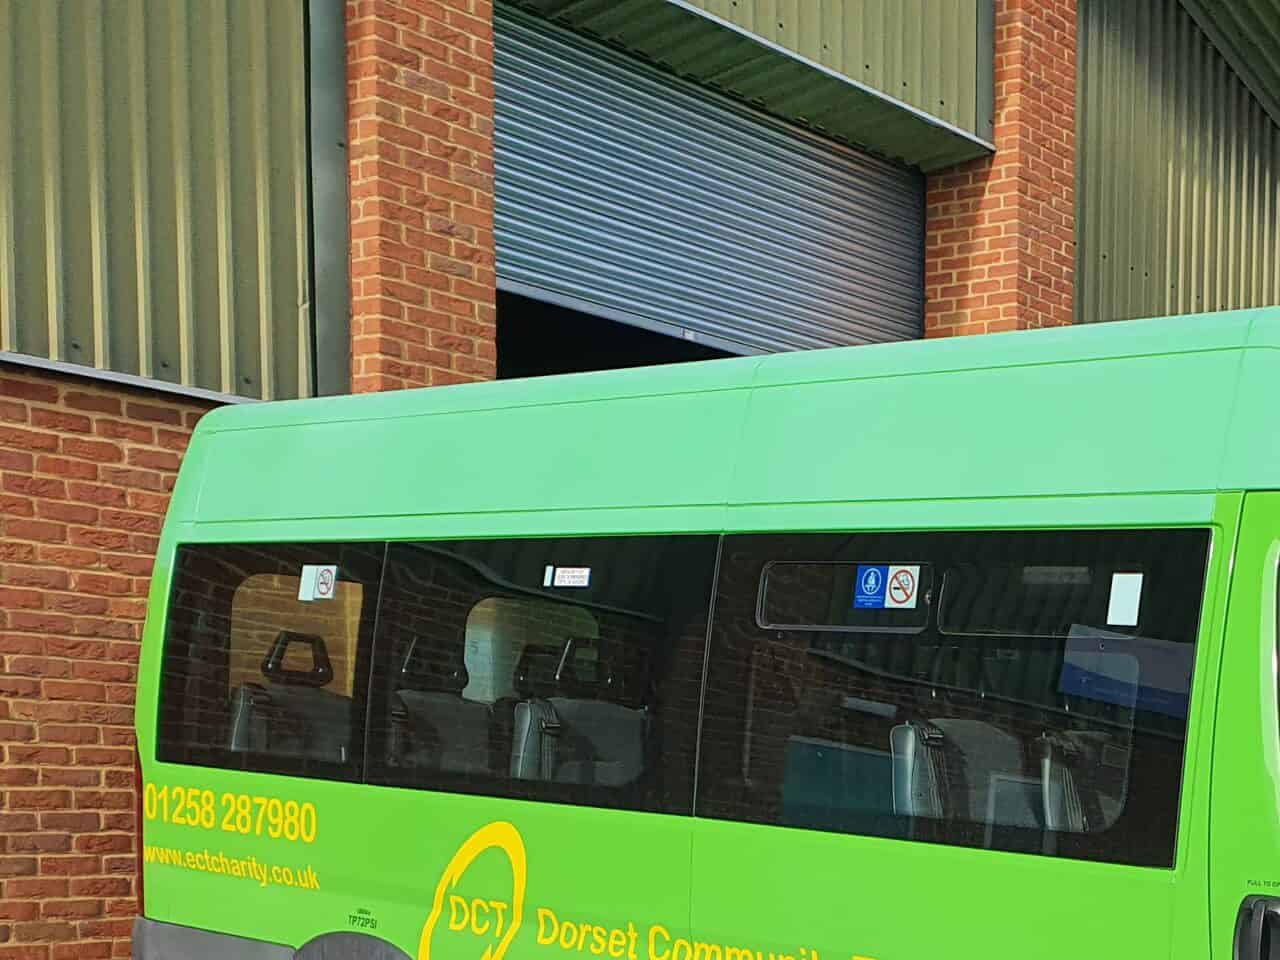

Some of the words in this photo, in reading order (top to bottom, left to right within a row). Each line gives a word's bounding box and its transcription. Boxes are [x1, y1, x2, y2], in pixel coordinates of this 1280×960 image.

[144, 783, 216, 829] 01258
[221, 793, 317, 843] 287980
[143, 845, 320, 889] www.ectcharity.co.uk
[448, 895, 508, 938] DCT
[536, 908, 640, 960] Dorset
